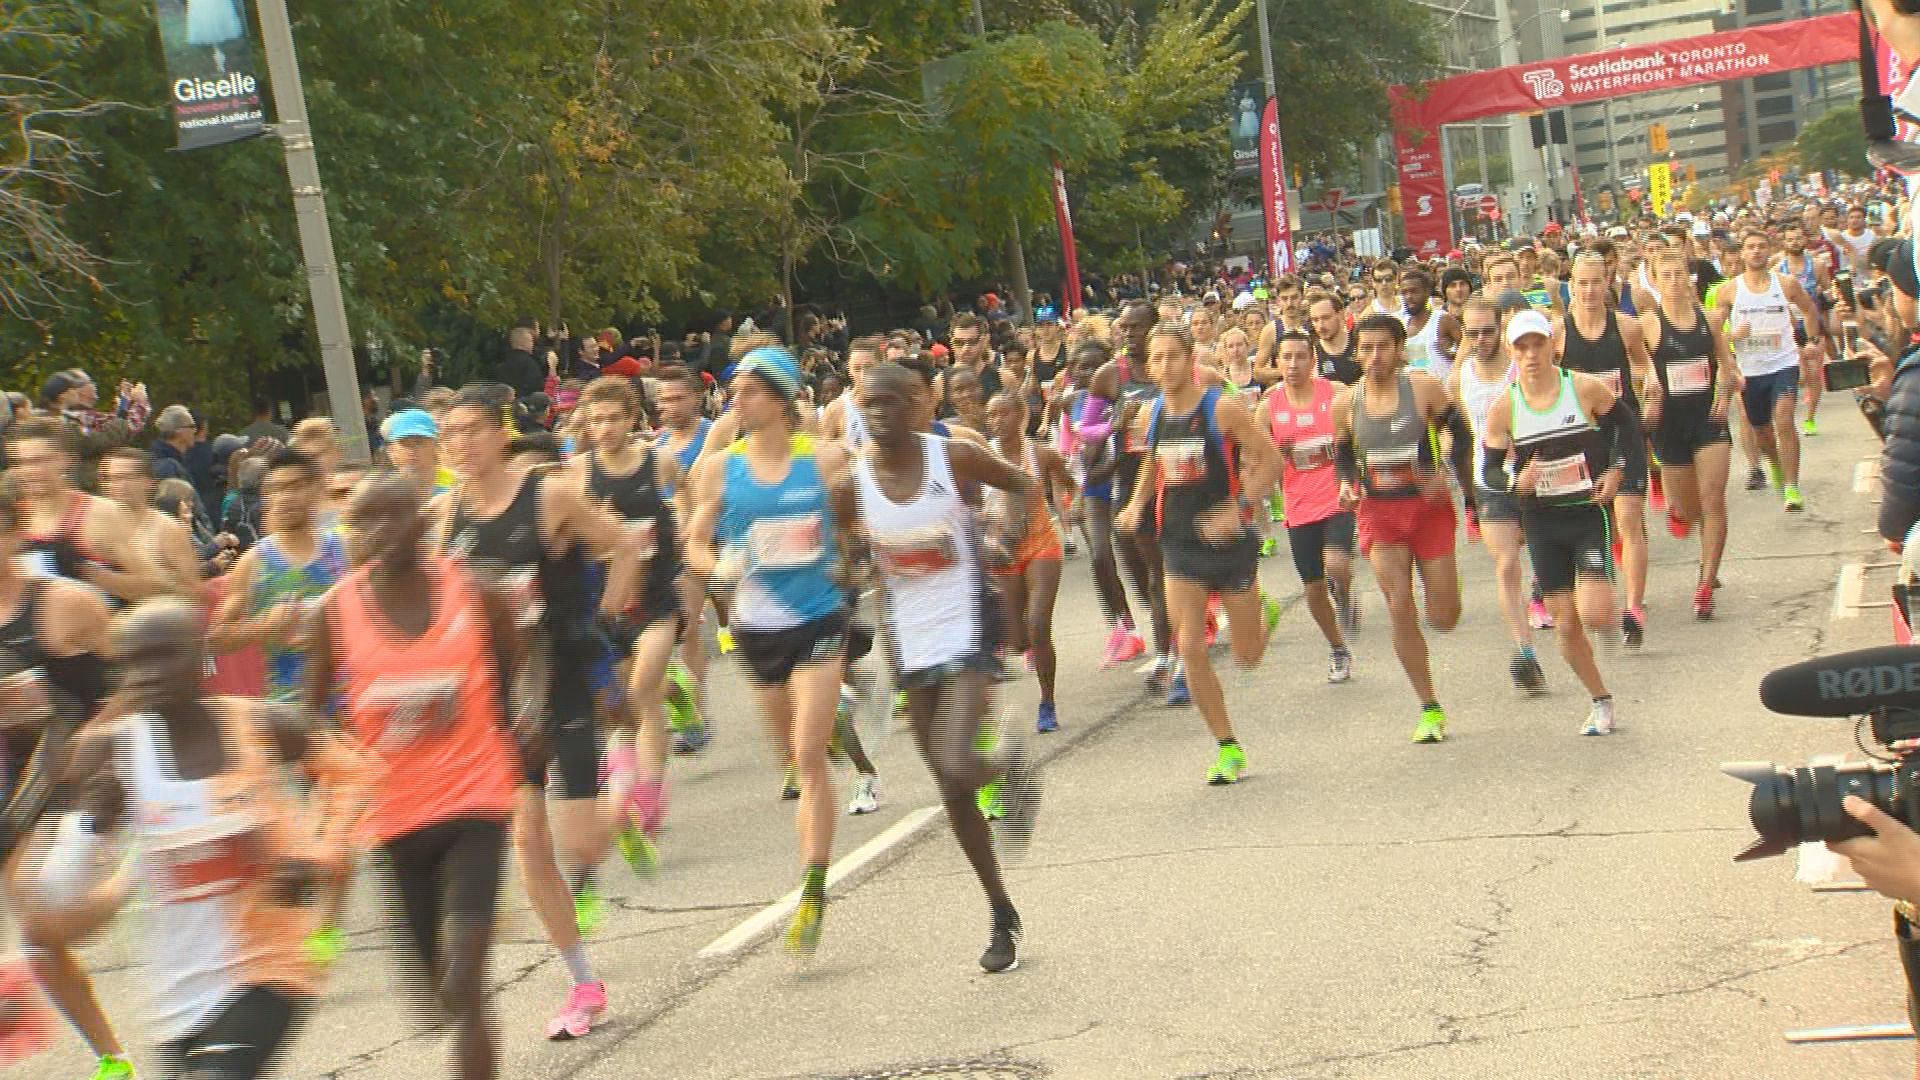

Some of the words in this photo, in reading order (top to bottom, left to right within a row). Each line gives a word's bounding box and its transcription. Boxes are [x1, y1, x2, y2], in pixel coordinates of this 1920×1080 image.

[1569, 52, 1666, 80] Scotiabank
[1669, 42, 1746, 64] TORONTO
[1570, 67, 1674, 94] WATERFRONT
[1679, 53, 1770, 78] MARATHON
[174, 72, 257, 101] Giselle
[1816, 663, 1920, 699] RØDE
